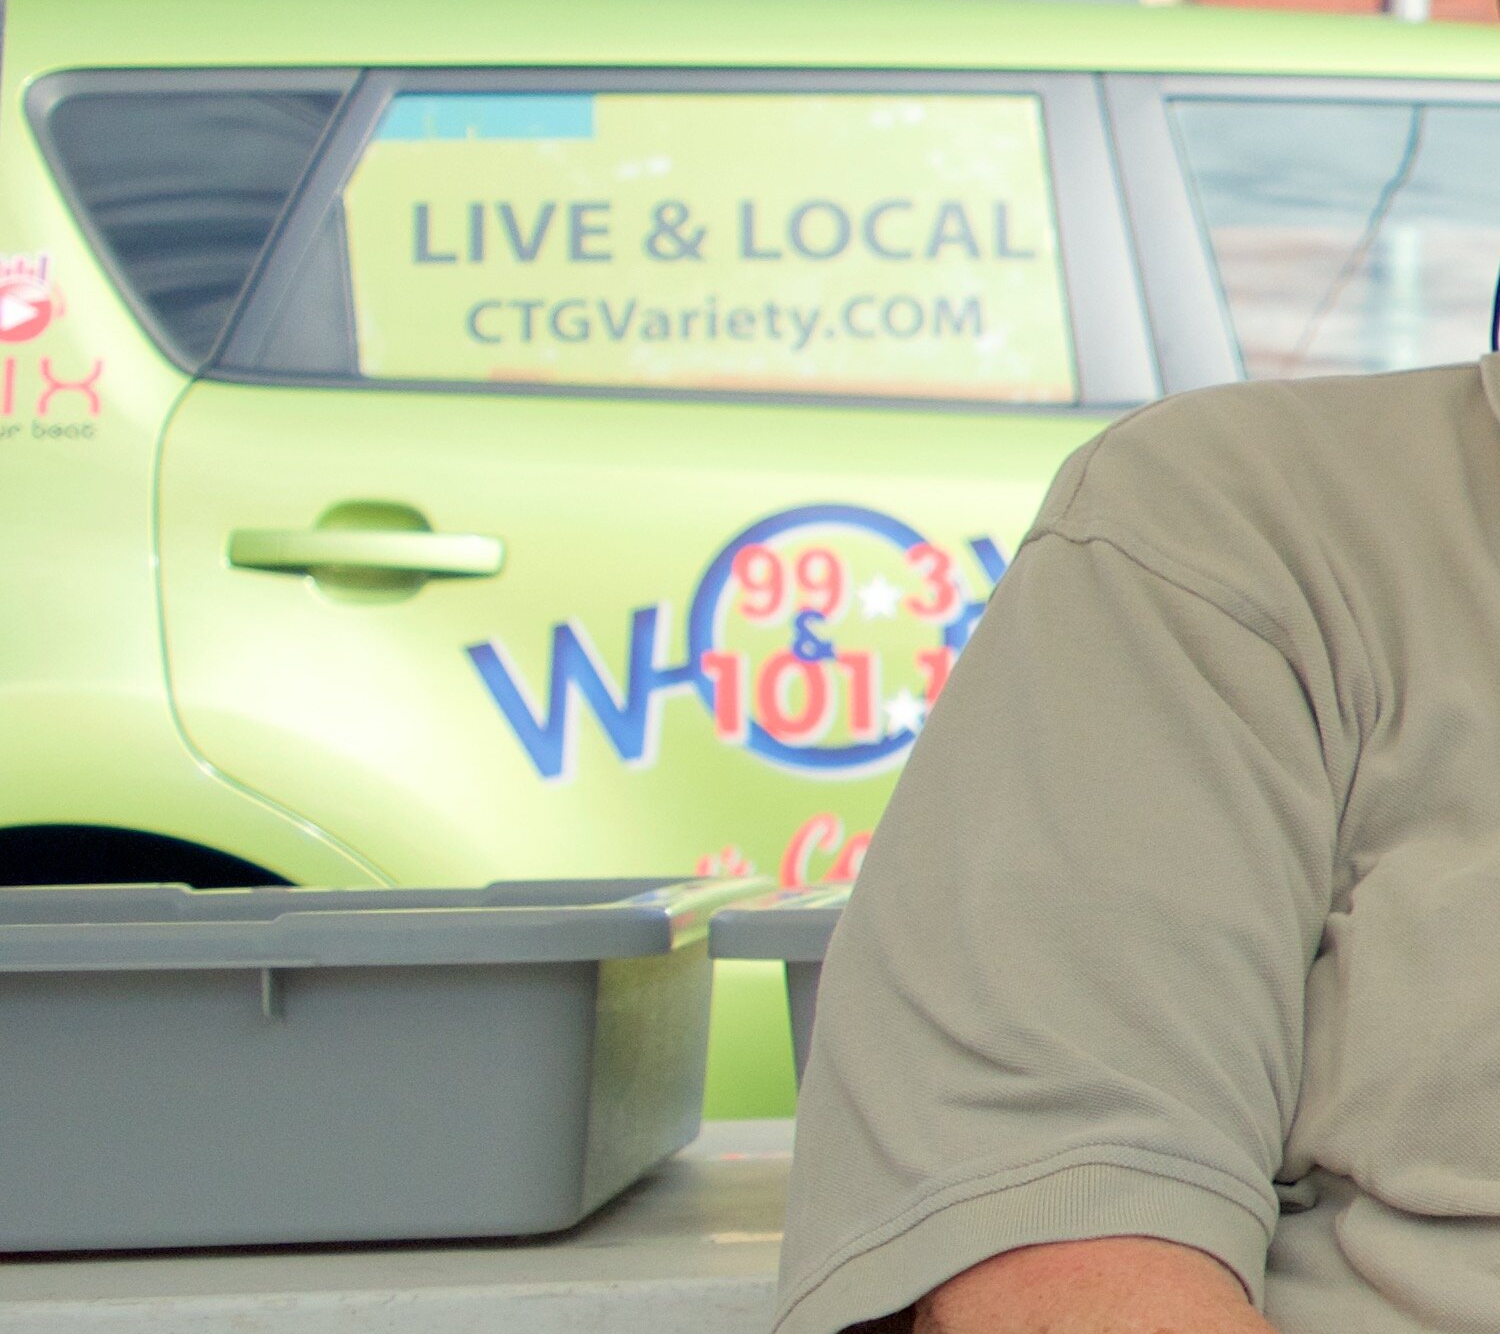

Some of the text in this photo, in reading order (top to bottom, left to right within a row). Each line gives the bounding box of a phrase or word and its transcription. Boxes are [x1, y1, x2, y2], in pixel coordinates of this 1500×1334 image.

[411, 197, 1035, 266] LIVE & LOCAL
[465, 294, 984, 350] CTGVariety.COM
